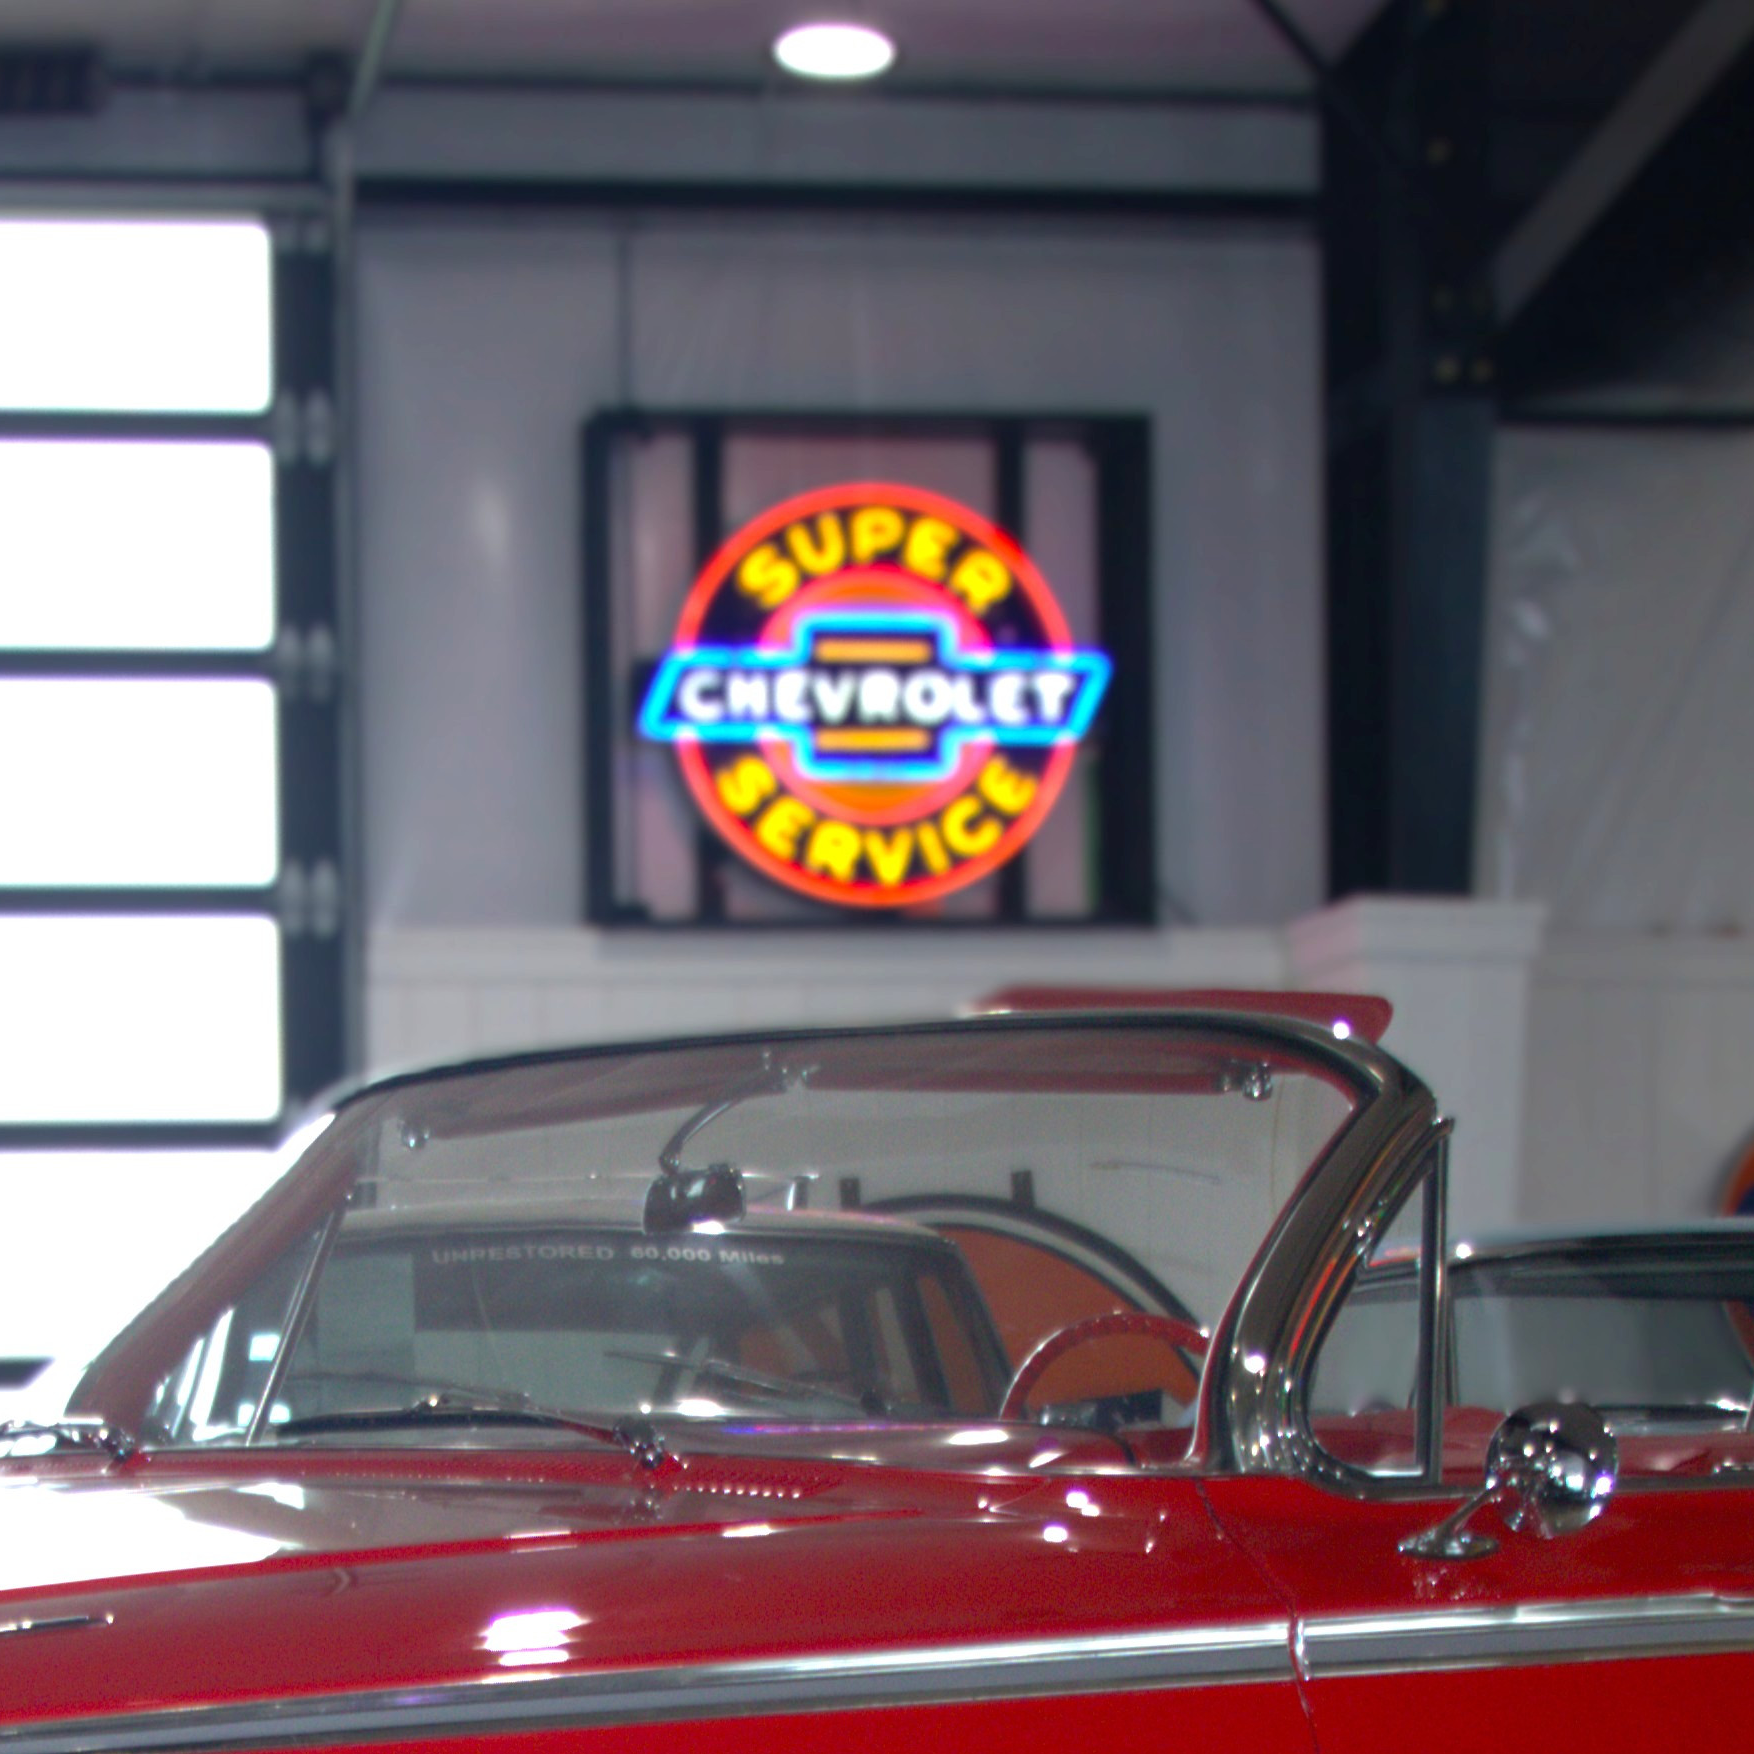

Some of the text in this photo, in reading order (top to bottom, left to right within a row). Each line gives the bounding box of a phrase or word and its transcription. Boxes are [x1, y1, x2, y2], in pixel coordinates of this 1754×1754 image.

[734, 503, 1013, 616] SUPER
[677, 668, 1079, 725] CHEVROLET
[715, 755, 1040, 887] SERVICE
